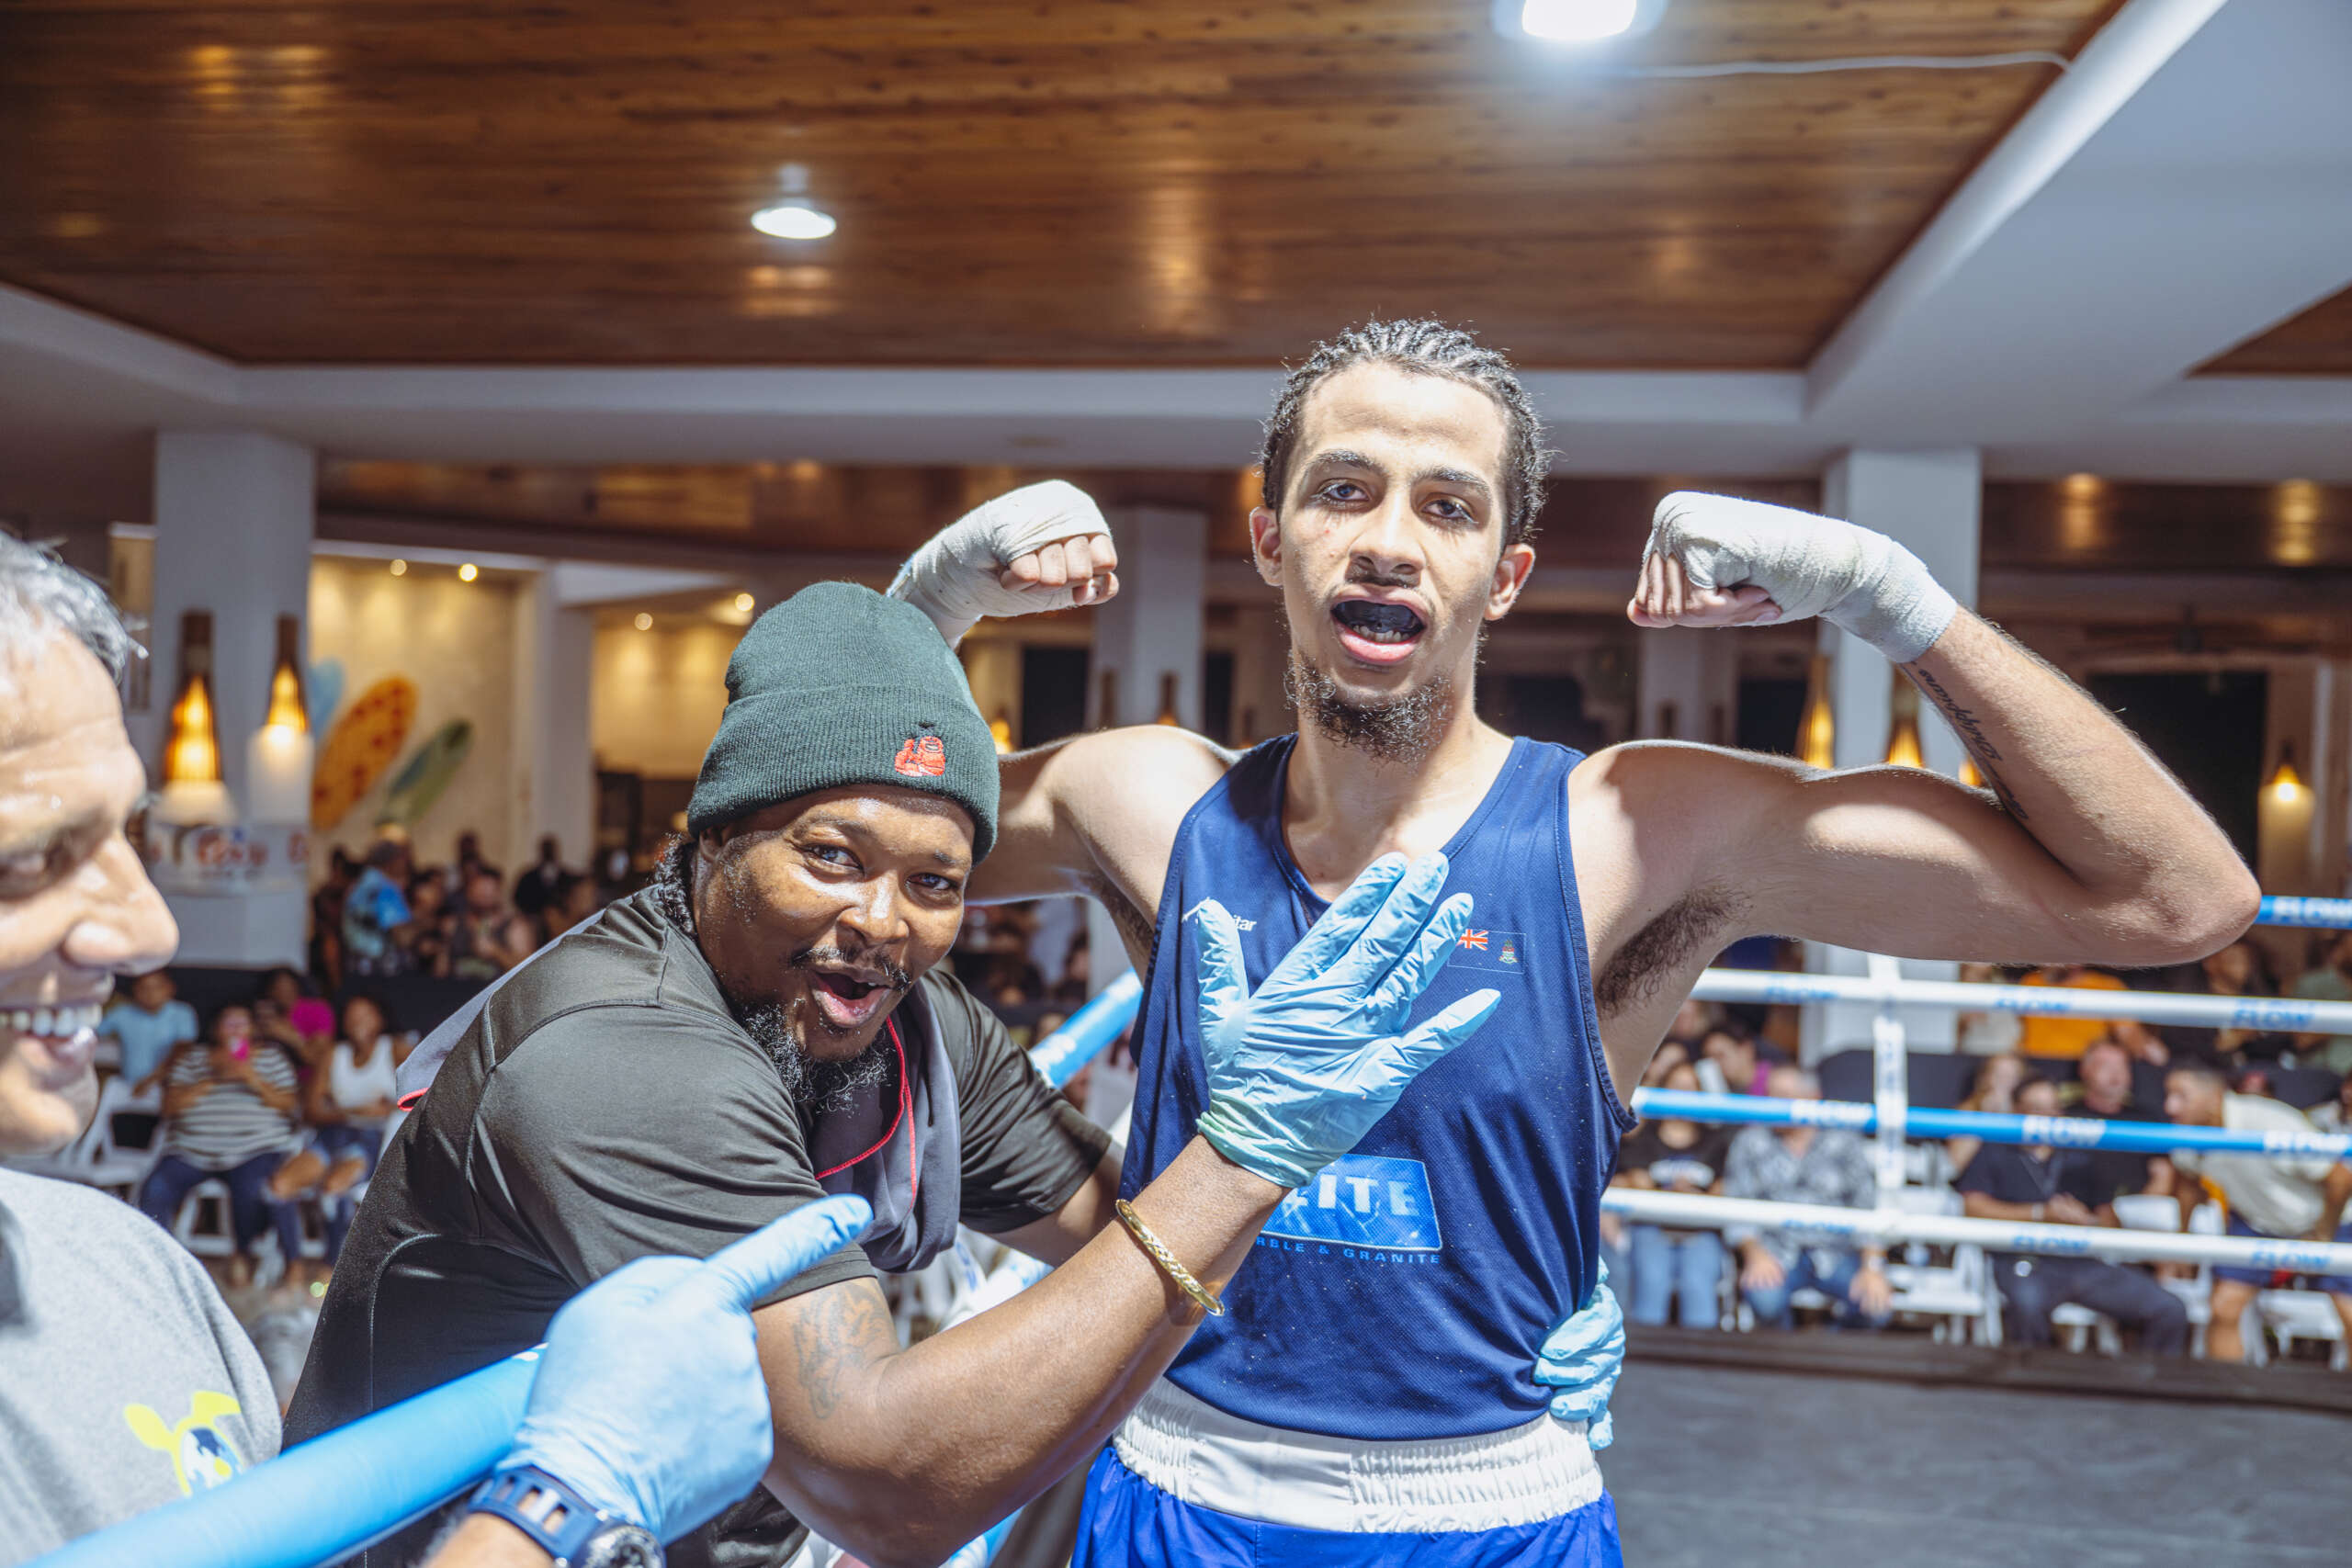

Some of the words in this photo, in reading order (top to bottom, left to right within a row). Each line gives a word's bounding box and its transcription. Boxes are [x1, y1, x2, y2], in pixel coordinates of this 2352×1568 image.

[2022, 1113, 2107, 1146] FLOW
[1256, 1235, 1305, 1253] RBLE
[1318, 1245, 1329, 1255] &
[1343, 1248, 1441, 1264] GRANITE
